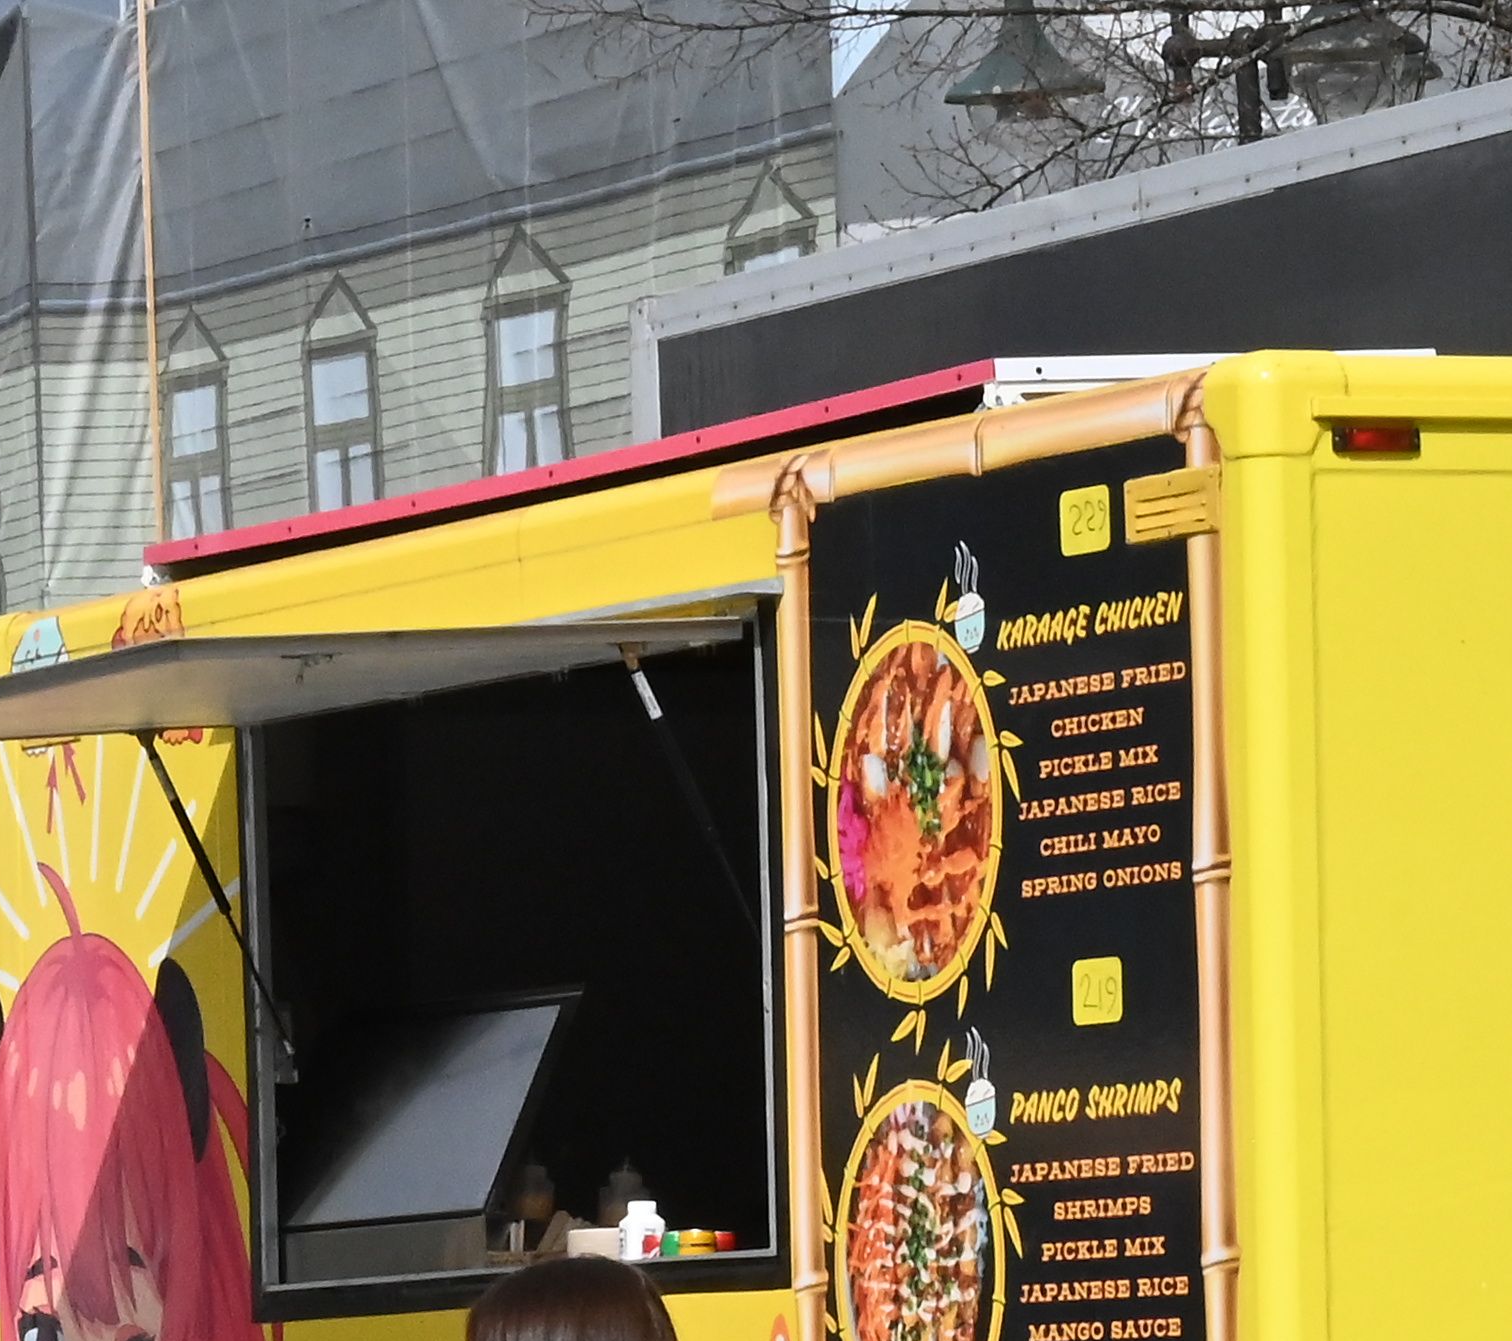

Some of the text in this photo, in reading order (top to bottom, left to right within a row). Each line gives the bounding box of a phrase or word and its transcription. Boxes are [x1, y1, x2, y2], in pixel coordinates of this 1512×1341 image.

[1069, 500, 1107, 535] 229
[997, 591, 1184, 651] KARAAGE CHICKEN
[1008, 661, 1187, 706] JAPANESE FRIED
[1050, 708, 1144, 739] CHICKEN
[1039, 744, 1159, 779] PICKLE MIX
[1018, 782, 1181, 821] JAPANESE RICE
[1039, 825, 1161, 857] CHILI MAYO
[1021, 861, 1182, 899] SPRING ONIONS
[1079, 972, 1118, 1014] 219
[1010, 1077, 1182, 1124] PANCO SHRIMPS
[1010, 1151, 1195, 1183] JAPANESE FRIED
[1053, 1196, 1152, 1220] SHRIMPS
[1041, 1235, 1166, 1262] PICKLE MIX
[1019, 1275, 1190, 1304] JAPANESE RICE
[1110, 1317, 1182, 1340] SAUCE
